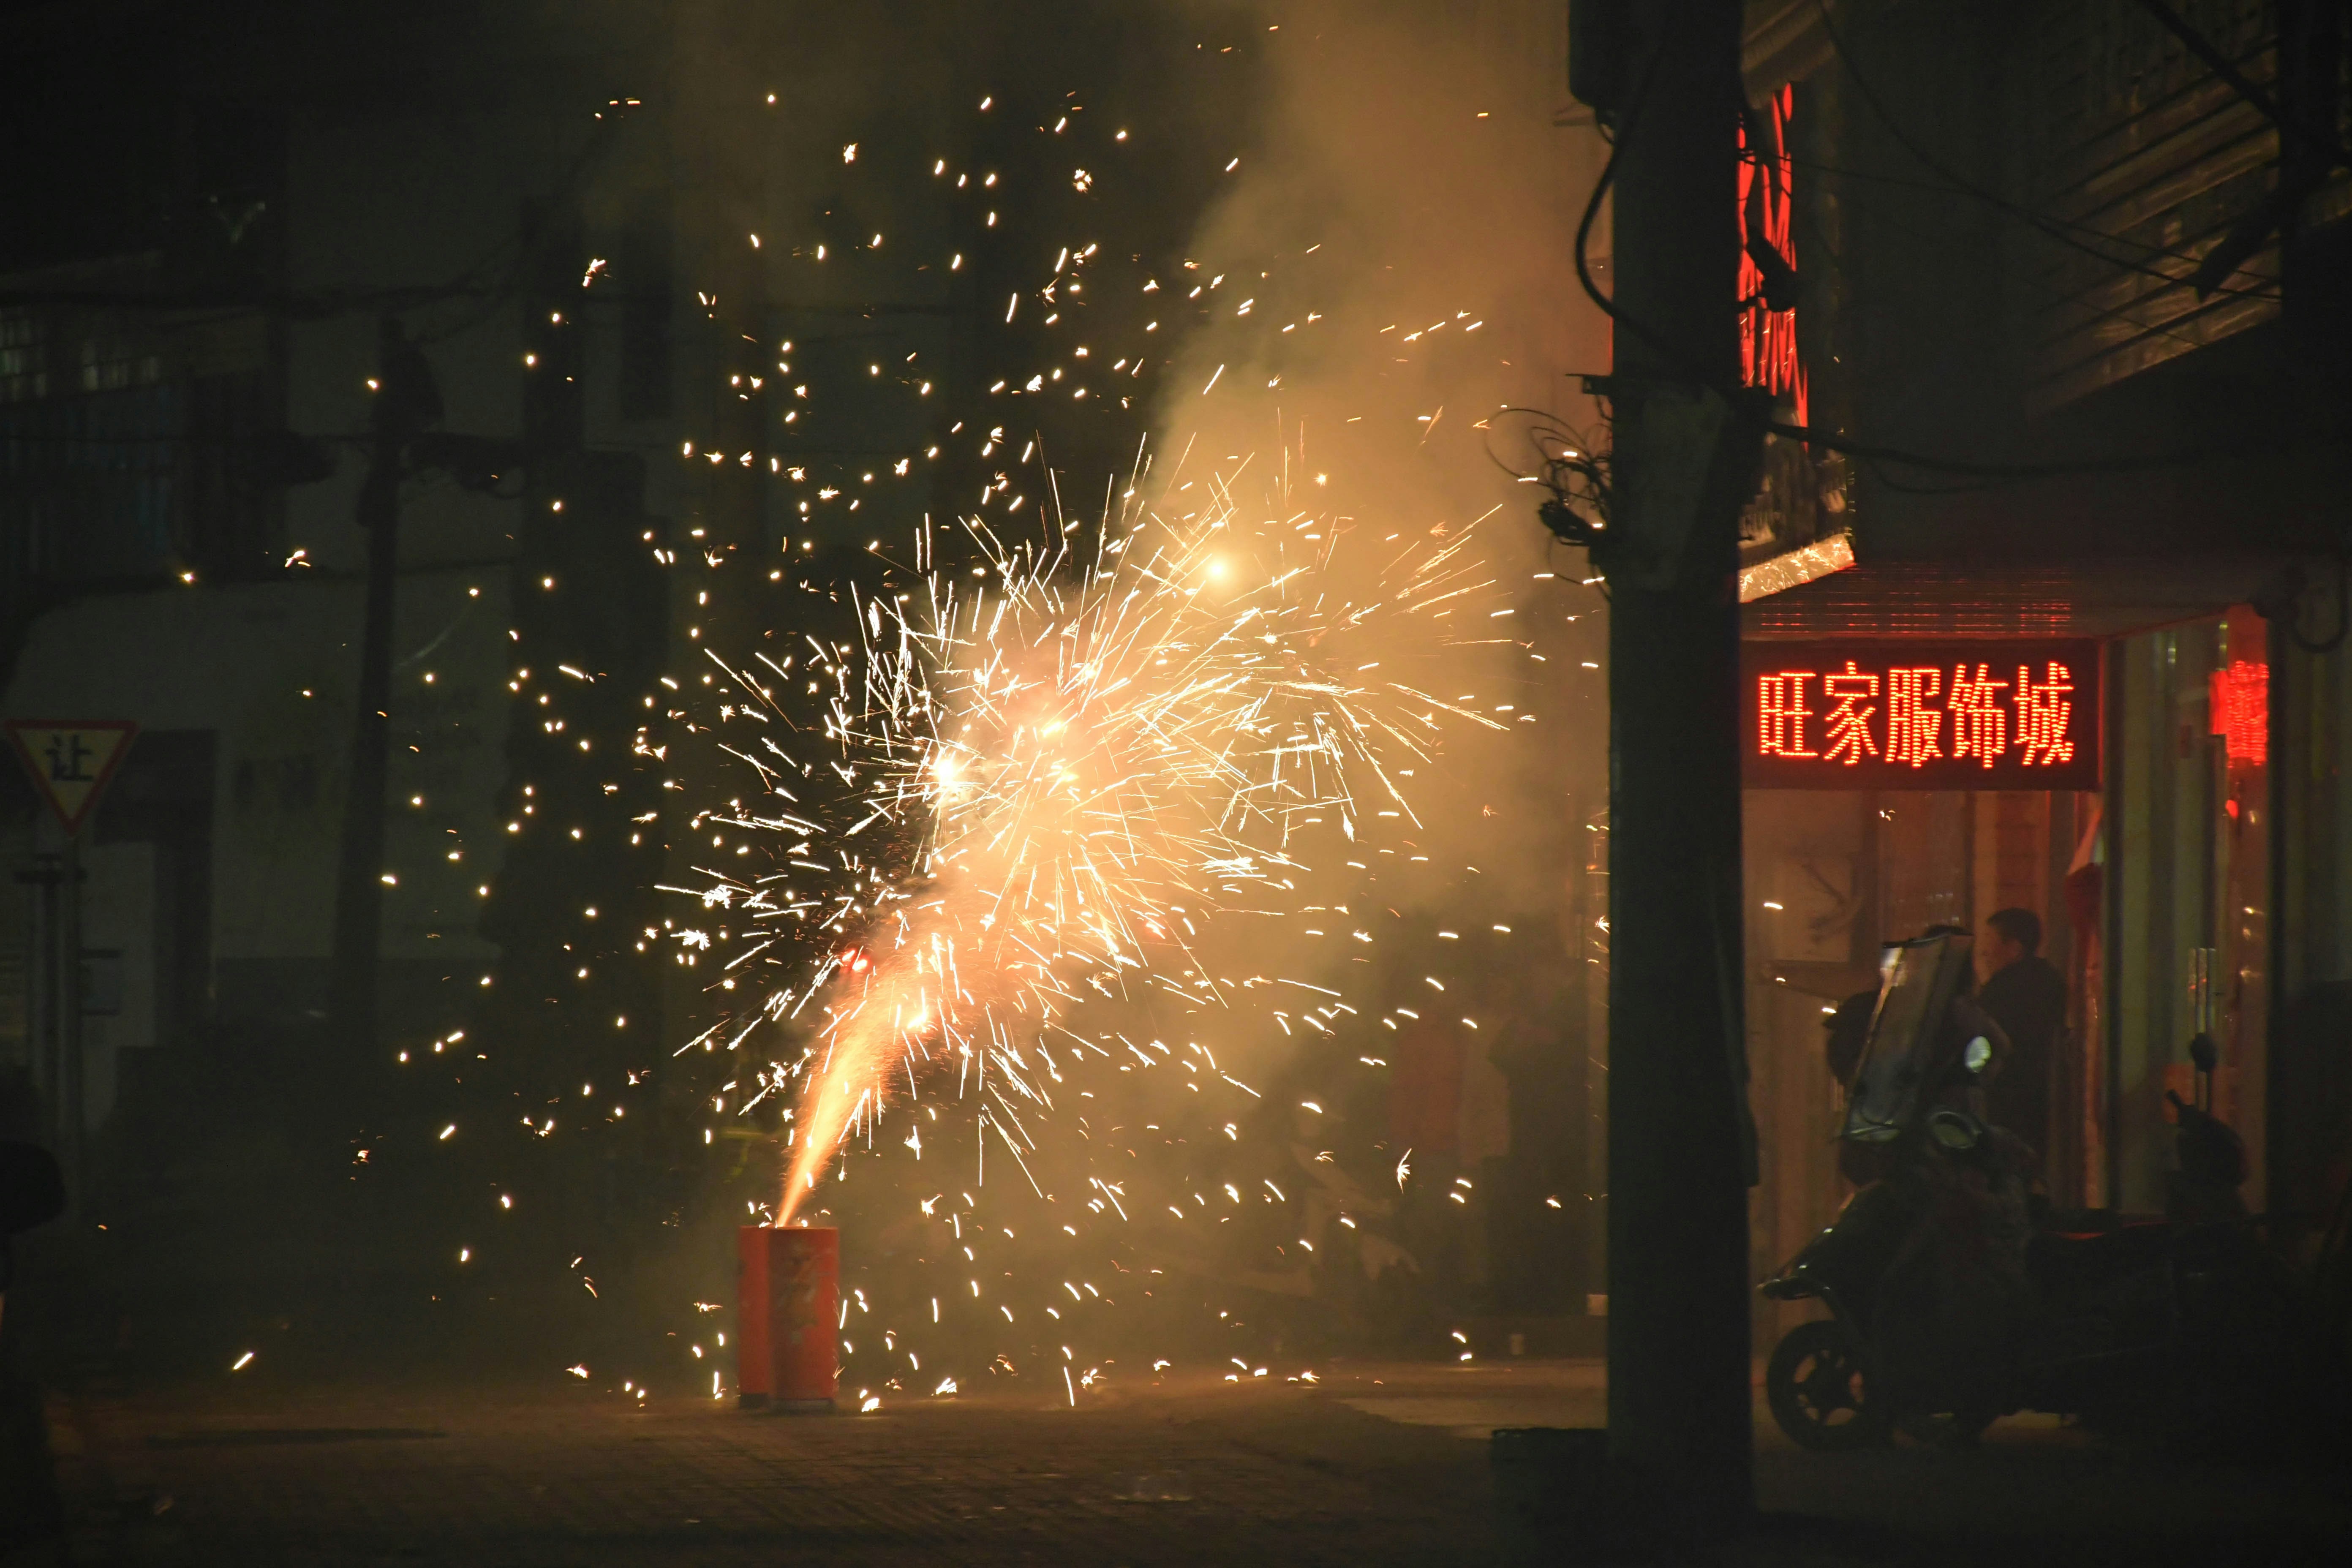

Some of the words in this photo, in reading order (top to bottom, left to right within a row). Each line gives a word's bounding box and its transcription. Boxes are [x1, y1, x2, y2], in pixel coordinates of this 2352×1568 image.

[1759, 661, 2074, 768] 旺家服饰城
[45, 734, 94, 782] 让
